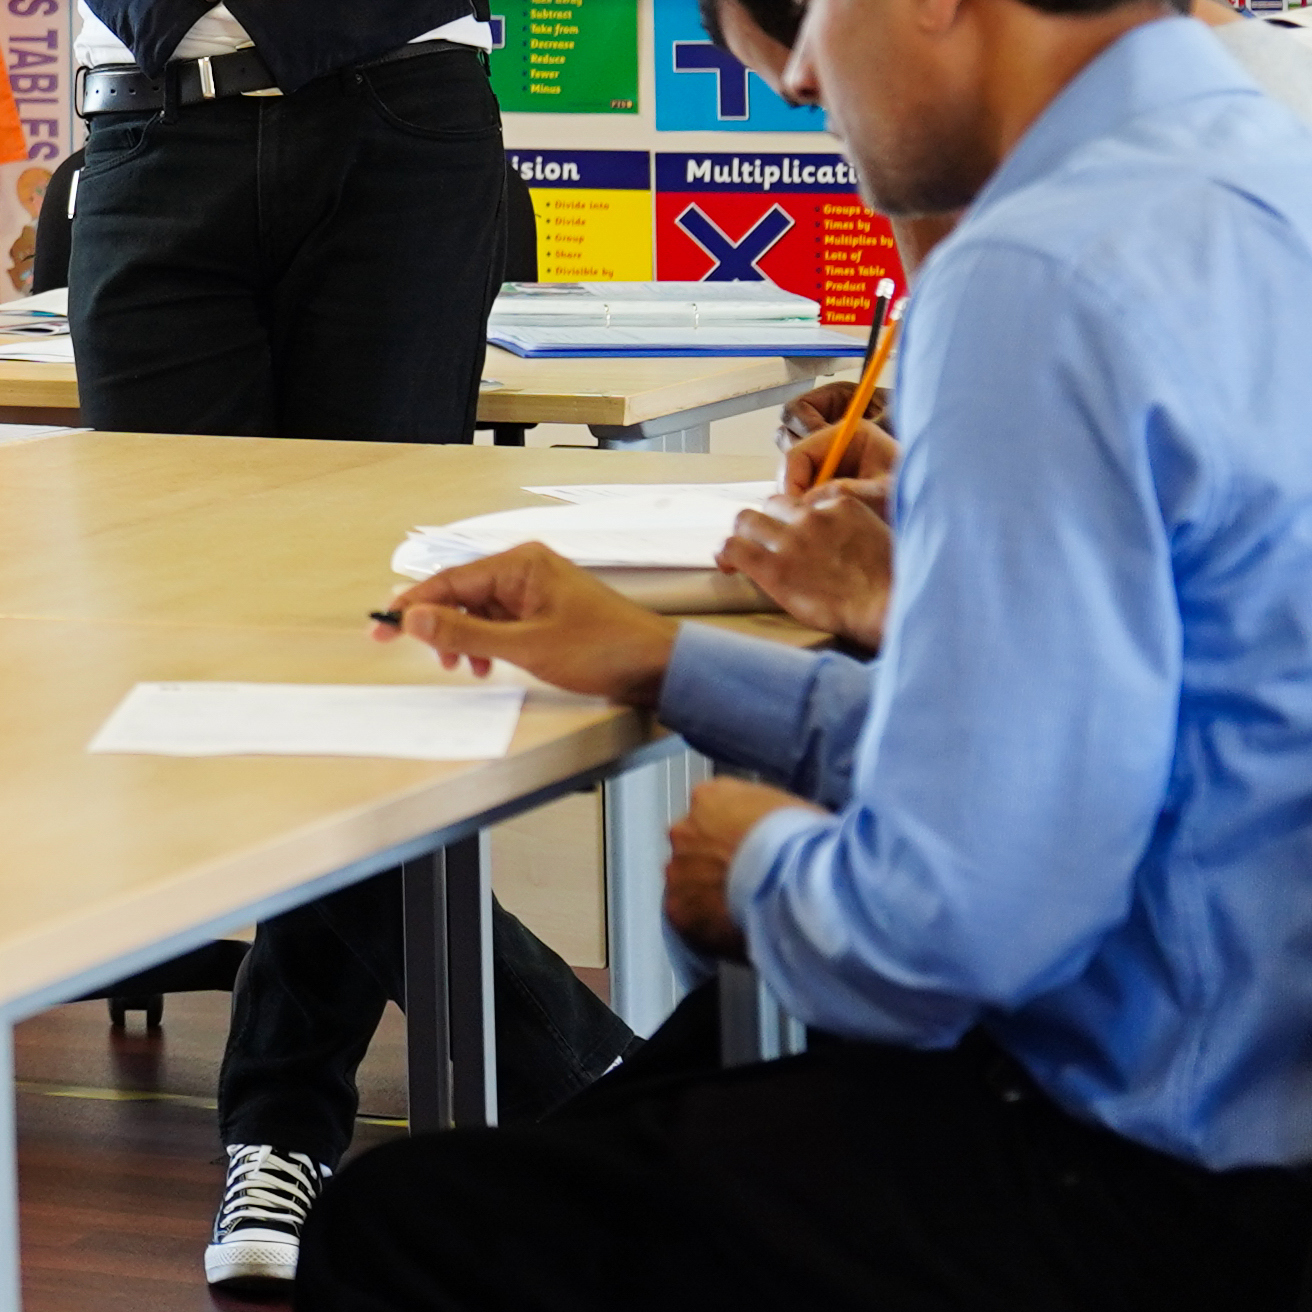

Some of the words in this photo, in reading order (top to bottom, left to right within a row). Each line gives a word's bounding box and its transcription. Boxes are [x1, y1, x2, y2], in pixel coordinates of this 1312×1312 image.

[530, 9, 572, 19] Subtract
[531, 23, 552, 34] Take
[553, 23, 579, 36] from
[530, 38, 574, 49] Decrease
[530, 53, 566, 64] Reduce
[530, 68, 559, 79] Fewer
[530, 83, 561, 94] Minus
[8, 28, 59, 162] TABLES
[512, 156, 580, 181] ision
[686, 158, 858, 190] Multiplicati
[555, 201, 586, 210] Divide
[589, 201, 609, 210] into
[823, 204, 861, 217] Groups
[555, 218, 586, 226] Divide
[824, 219, 854, 230] Times
[857, 219, 871, 233] by
[555, 234, 584, 244] Group
[824, 234, 877, 248] Multiplies
[880, 235, 894, 248] by
[555, 250, 582, 259] Share
[825, 250, 847, 261] Lots
[850, 250, 863, 263] of
[602, 267, 614, 278] by
[825, 265, 855, 276] Times
[858, 265, 886, 277] Table
[825, 280, 866, 292] Product
[826, 296, 870, 309] Multiply
[826, 311, 856, 322] Times
